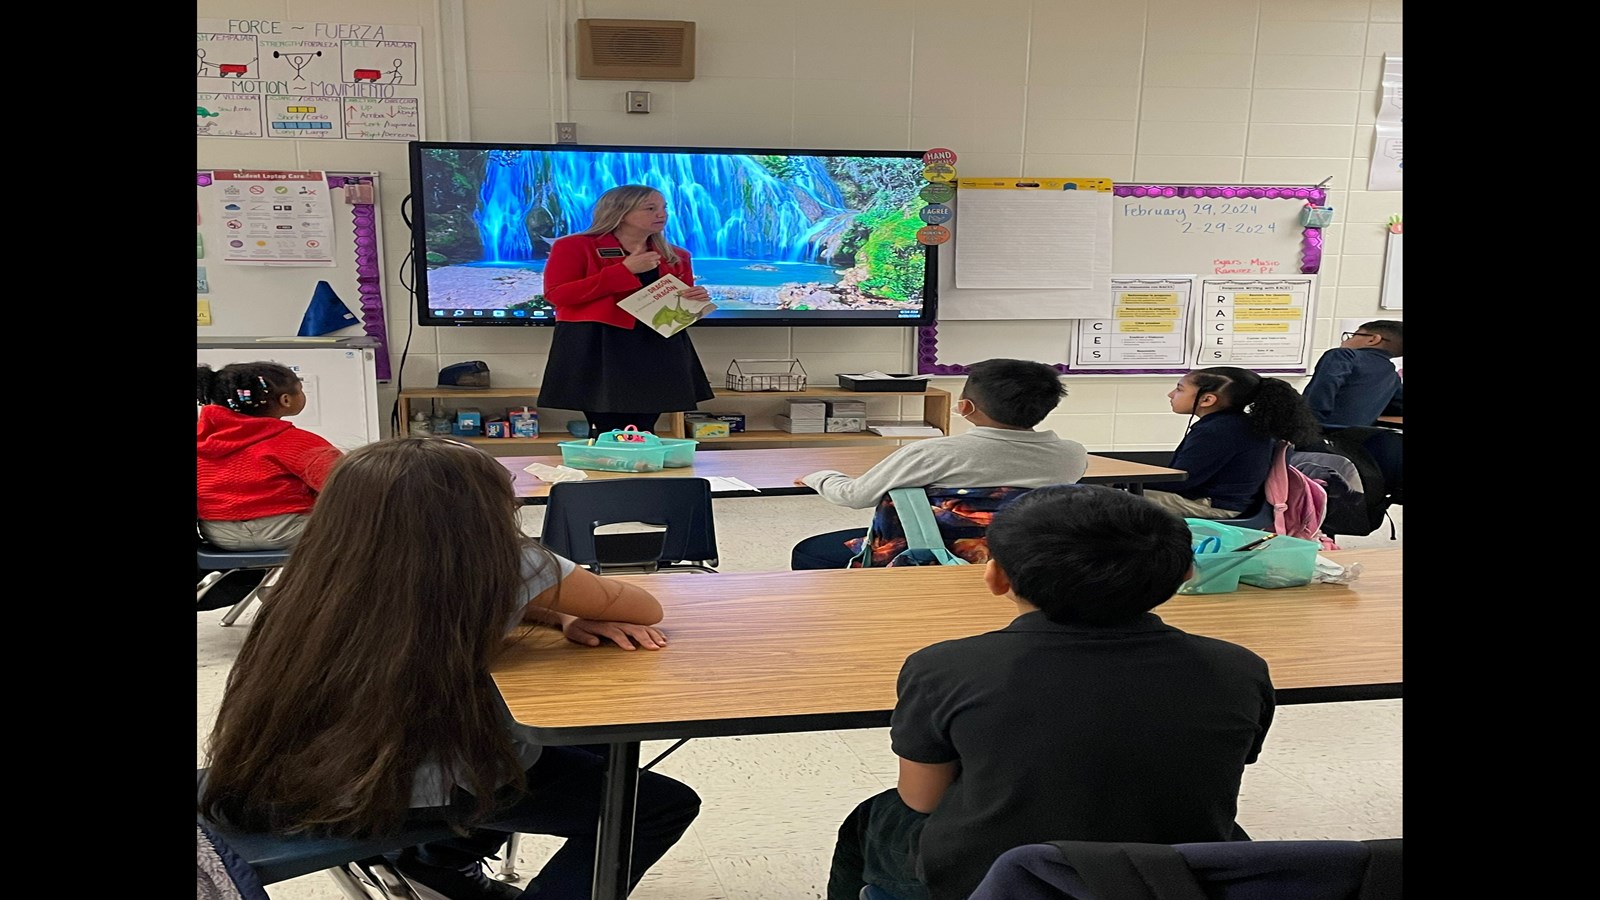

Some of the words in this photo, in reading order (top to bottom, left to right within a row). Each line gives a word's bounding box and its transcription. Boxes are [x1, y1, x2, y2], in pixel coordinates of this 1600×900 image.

[228, 19, 282, 34] FORCE
[315, 22, 384, 40] FUERZA
[232, 80, 289, 94] MOTION
[310, 80, 395, 98] MOVIMIENTO
[926, 151, 952, 160] HAND
[233, 172, 261, 180] Student
[1124, 202, 1188, 223] February
[1193, 203, 1217, 216] 29,
[1221, 203, 1257, 215] 2024
[1217, 295, 1226, 304] R
[1215, 309, 1226, 318] A
[1092, 322, 1103, 331] C
[1215, 323, 1225, 332] C
[1094, 336, 1102, 345] E
[1216, 337, 1224, 346] E
[1092, 350, 1102, 359] S
[1213, 351, 1222, 359] S
